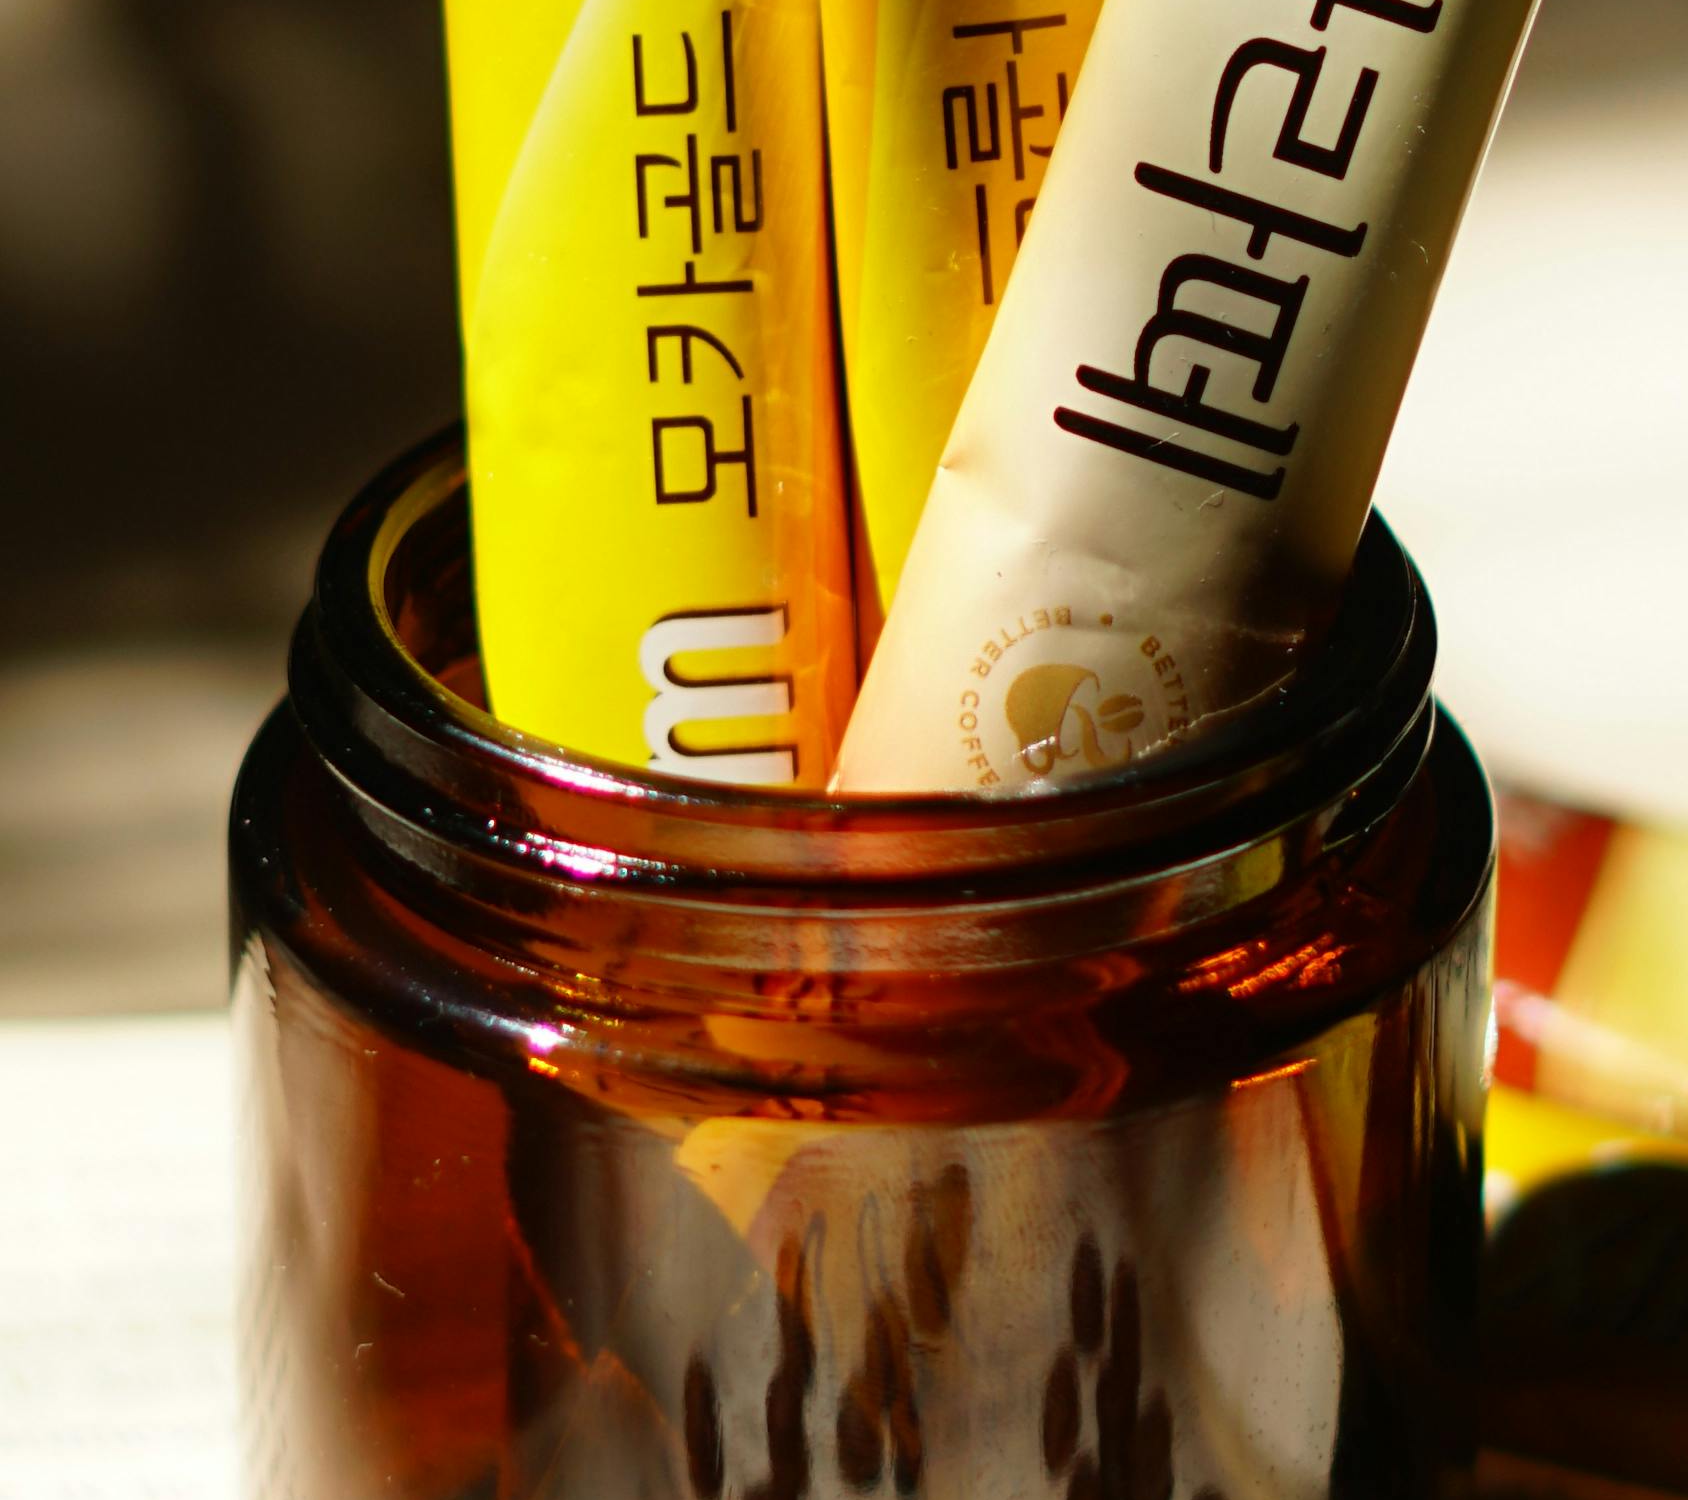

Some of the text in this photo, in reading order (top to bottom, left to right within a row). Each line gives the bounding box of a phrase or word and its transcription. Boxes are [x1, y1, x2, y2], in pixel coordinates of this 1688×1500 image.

[630, 8, 764, 520] 모카골드
[957, 605, 1074, 788] BETTER COFFE
[1139, 634, 1192, 735] BETTE
